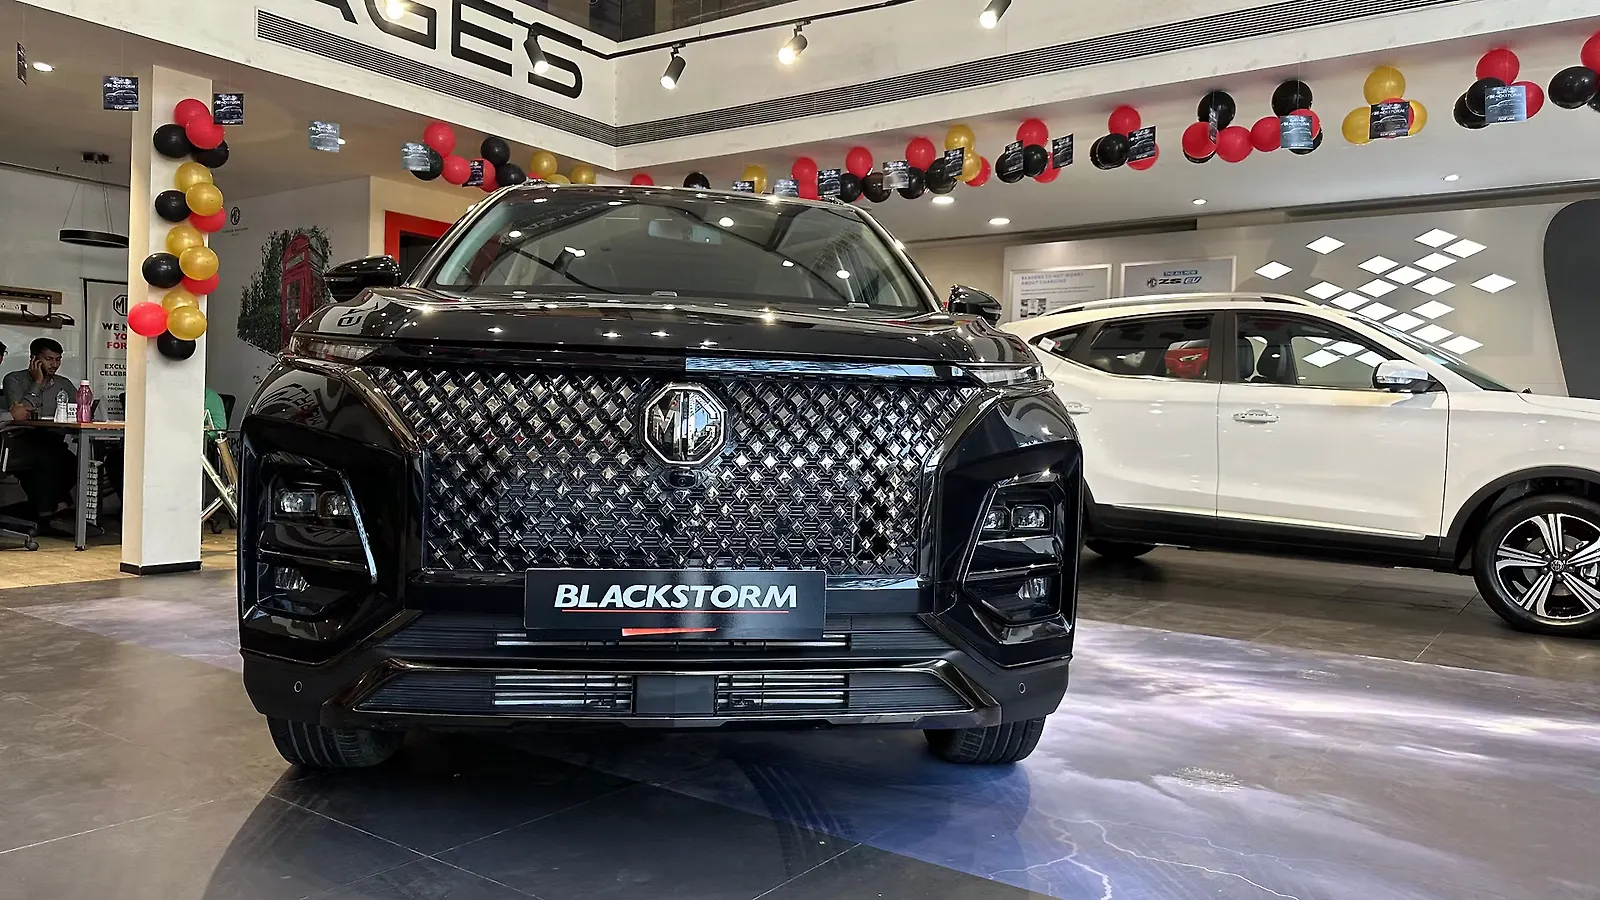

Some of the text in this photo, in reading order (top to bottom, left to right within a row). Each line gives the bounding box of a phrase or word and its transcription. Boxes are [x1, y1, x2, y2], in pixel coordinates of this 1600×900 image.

[315, 0, 583, 99] GES
[102, 322, 120, 331] WE
[113, 332, 128, 341] YO
[107, 341, 128, 350] FOR
[646, 387, 721, 461] MG
[554, 583, 797, 609] BLACKSTORM
